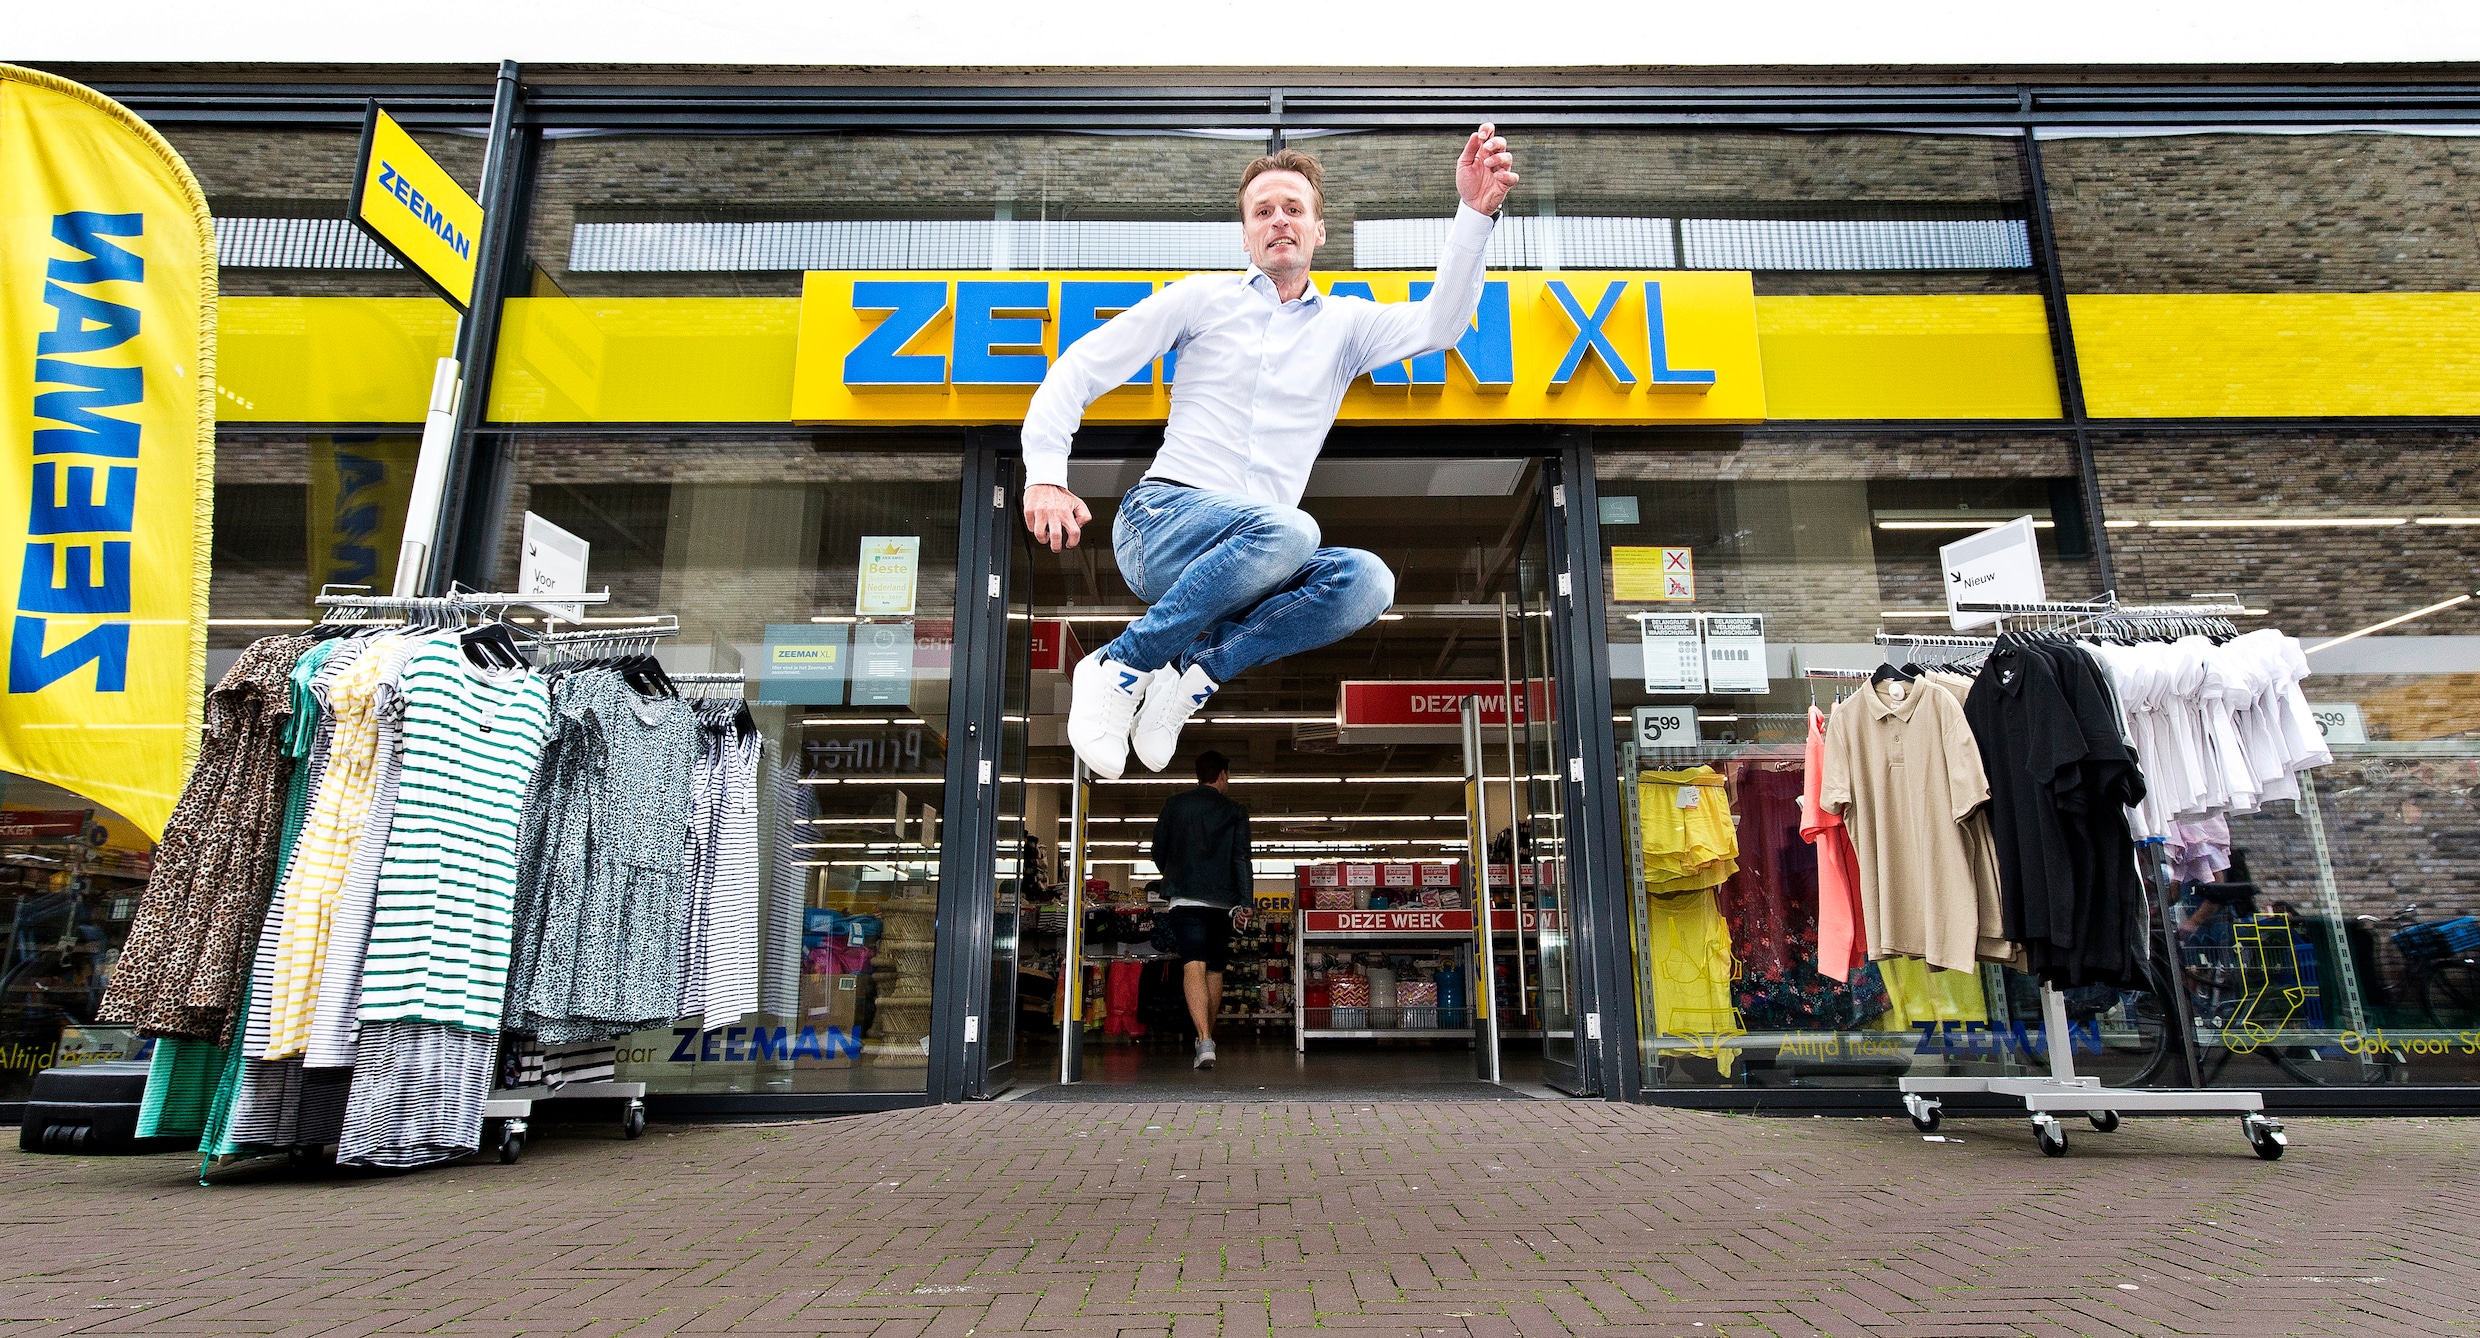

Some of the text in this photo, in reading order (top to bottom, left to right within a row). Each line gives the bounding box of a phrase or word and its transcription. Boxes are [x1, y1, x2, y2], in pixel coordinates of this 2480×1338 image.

[378, 160, 470, 262] ZEEMAN
[843, 281, 1717, 388] ZEEN XL
[534, 568, 556, 588] Voor
[869, 563, 907, 573] Beste
[868, 583, 906, 591] Nederland
[1964, 573, 1995, 588] Nieuw
[1338, 913, 1444, 928] DEZE WEEK
[616, 1025, 861, 1063] aar ZEEMAN
[1778, 1030, 1838, 1063] Altijd
[2341, 1028, 2393, 1055] Ook
[2400, 1038, 2452, 1055] voor
